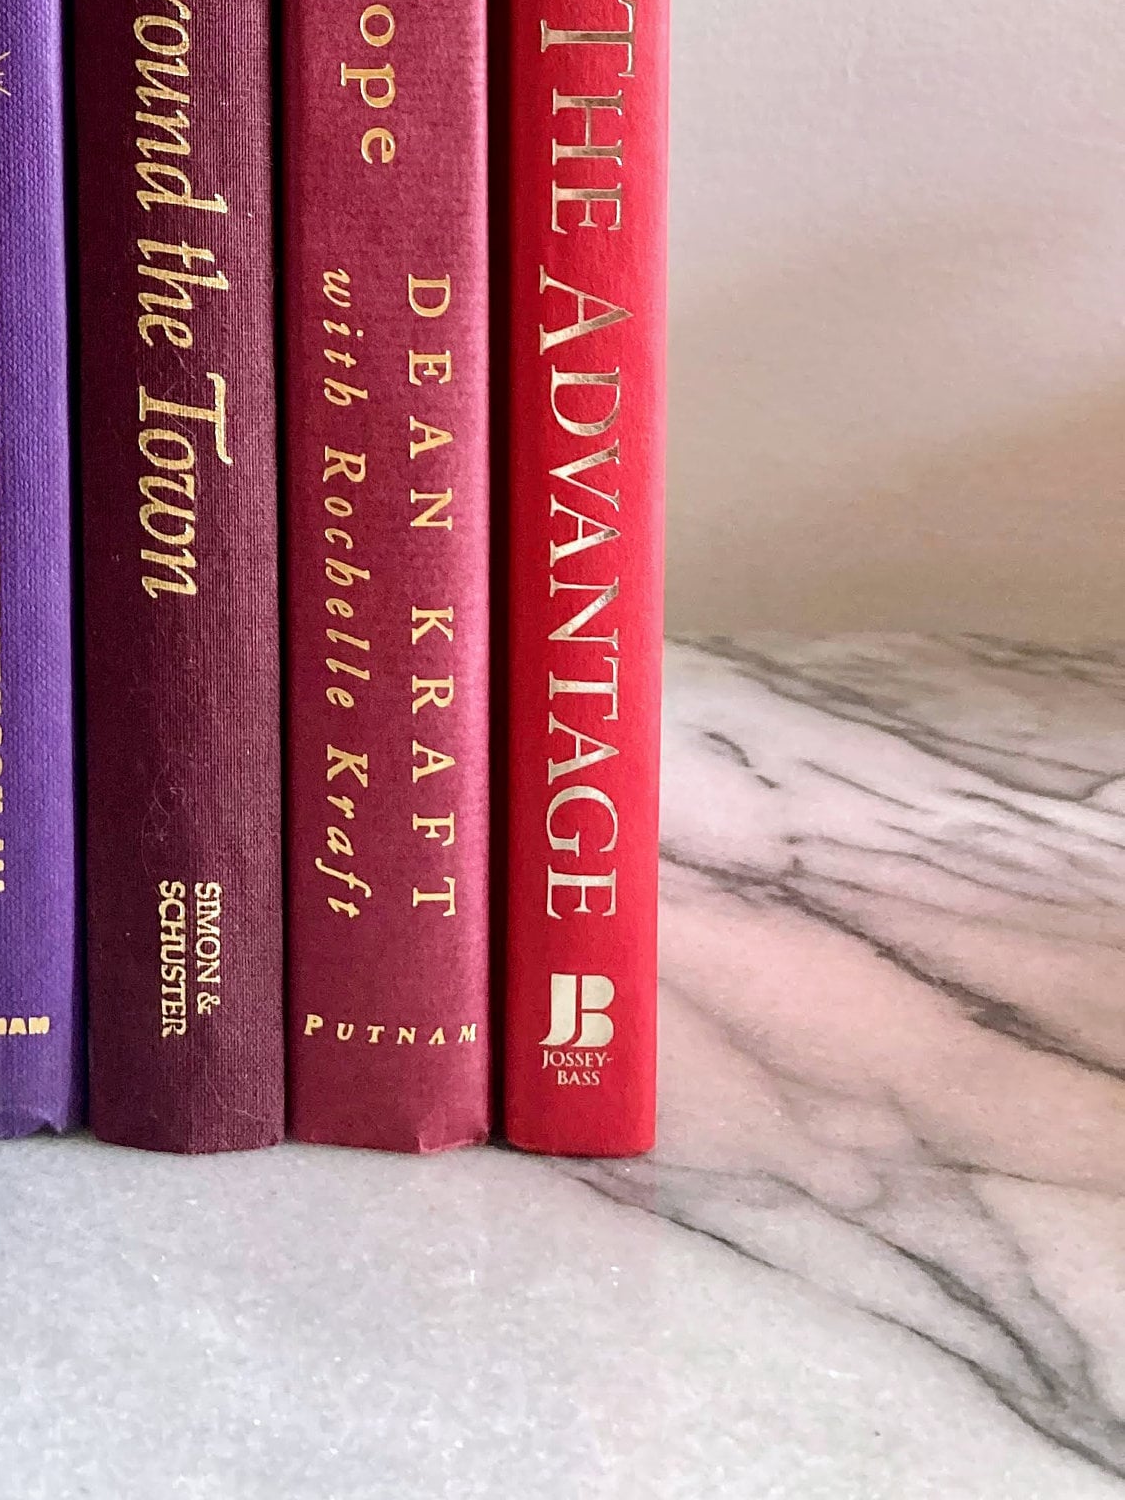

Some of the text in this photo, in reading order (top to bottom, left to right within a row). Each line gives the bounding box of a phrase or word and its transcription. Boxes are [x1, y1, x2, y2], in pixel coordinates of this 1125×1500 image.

[136, 237, 230, 349] the
[138, 372, 232, 598] Town
[315, 268, 371, 918] with Rochelle Kraft
[407, 273, 456, 917] DEAN KRAFT
[539, 264, 633, 919] ADVANTAGE
[158, 880, 187, 1038] SCHUSTER
[194, 881, 221, 1015] SIMON &
[539, 973, 615, 1048] JB
[304, 1013, 478, 1046] PUTNAM
[542, 1049, 613, 1070] JOSSEY-
[557, 1068, 601, 1087] BASS
